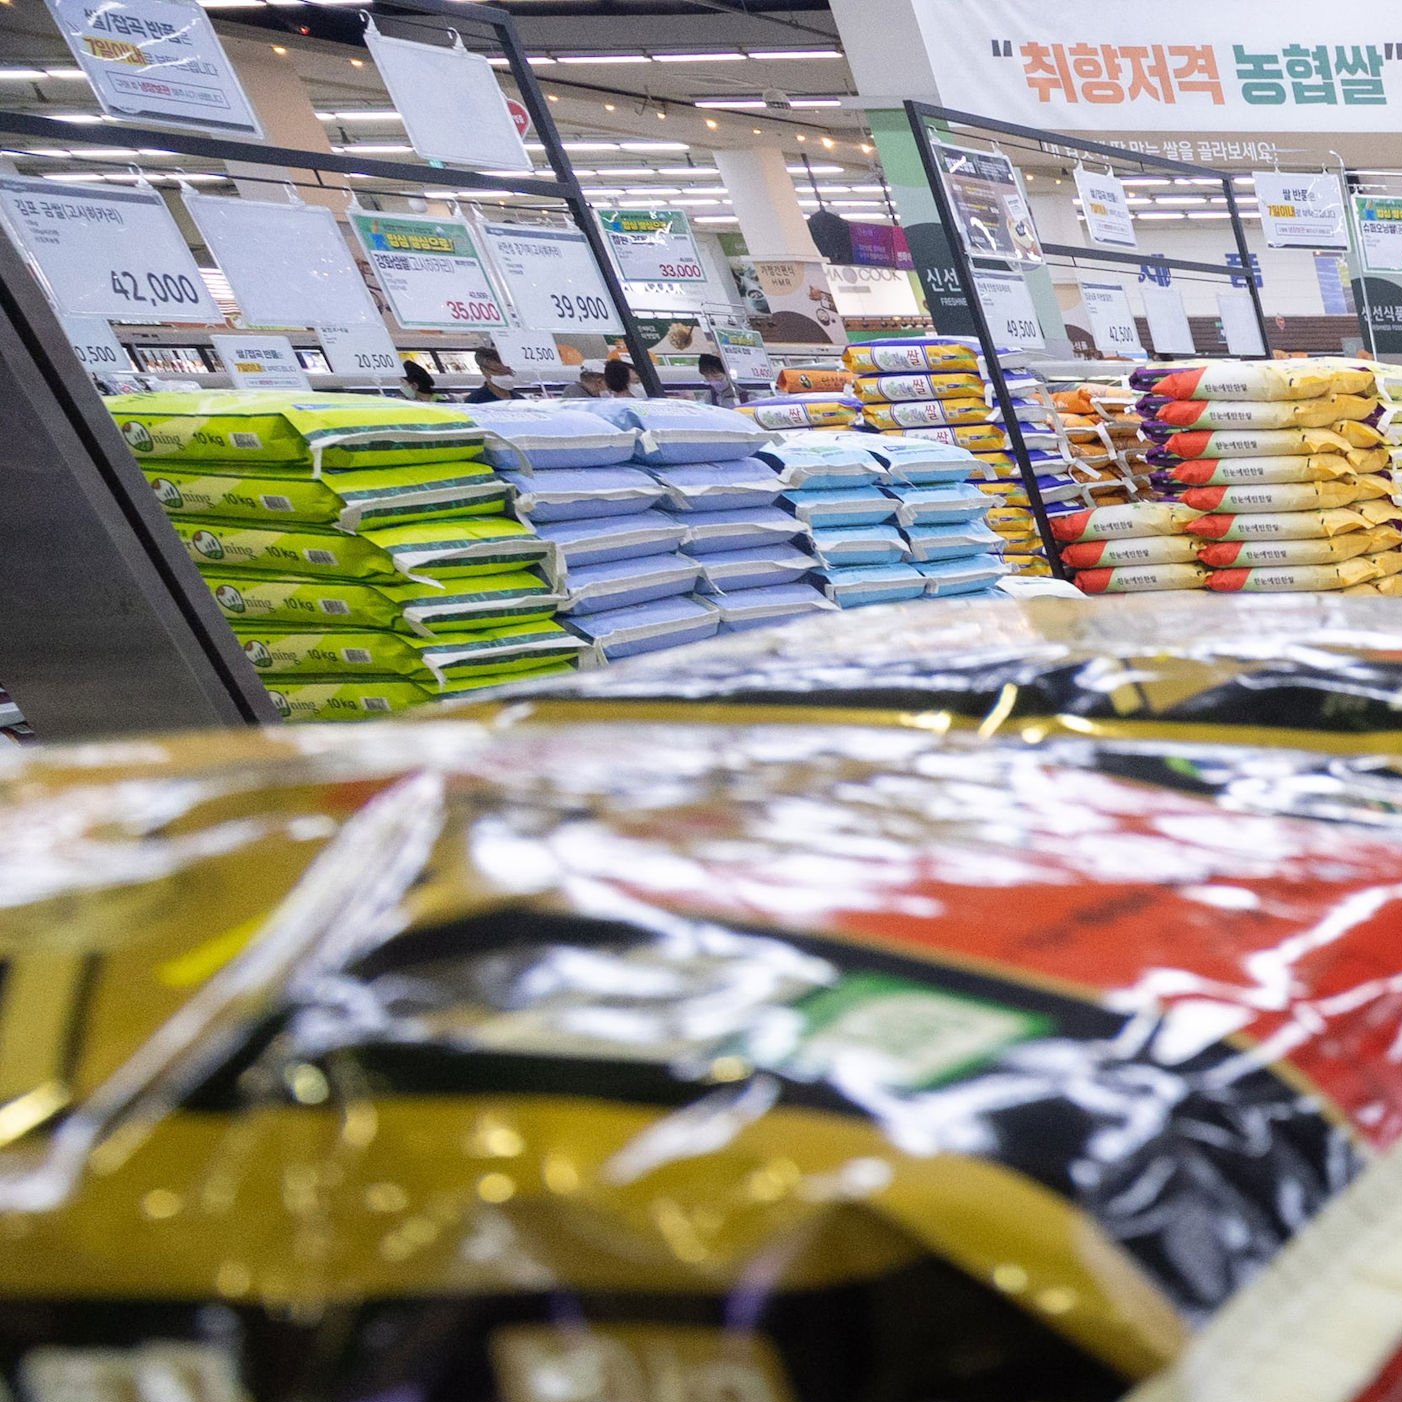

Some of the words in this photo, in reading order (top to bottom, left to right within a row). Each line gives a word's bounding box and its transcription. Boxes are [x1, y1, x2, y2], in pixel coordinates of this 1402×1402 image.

[1163, 141, 1194, 161] 쌀을
[1198, 141, 1279, 163] 골라보세요!
[1283, 188, 1291, 200] 쌀
[14, 199, 41, 216] 김포
[42, 201, 124, 225] 금쌀(고시히카리)
[659, 263, 701, 279] 33,000
[761, 264, 795, 278] 가정간편식
[927, 268, 962, 293] 신선
[110, 270, 199, 307] 42,000
[771, 278, 792, 287] HMR
[446, 300, 500, 322] 35,000
[551, 294, 609, 322] 39,900
[1007, 320, 1036, 339] 49,500
[355, 353, 395, 370] 20,500
[521, 346, 555, 361] 22,500
